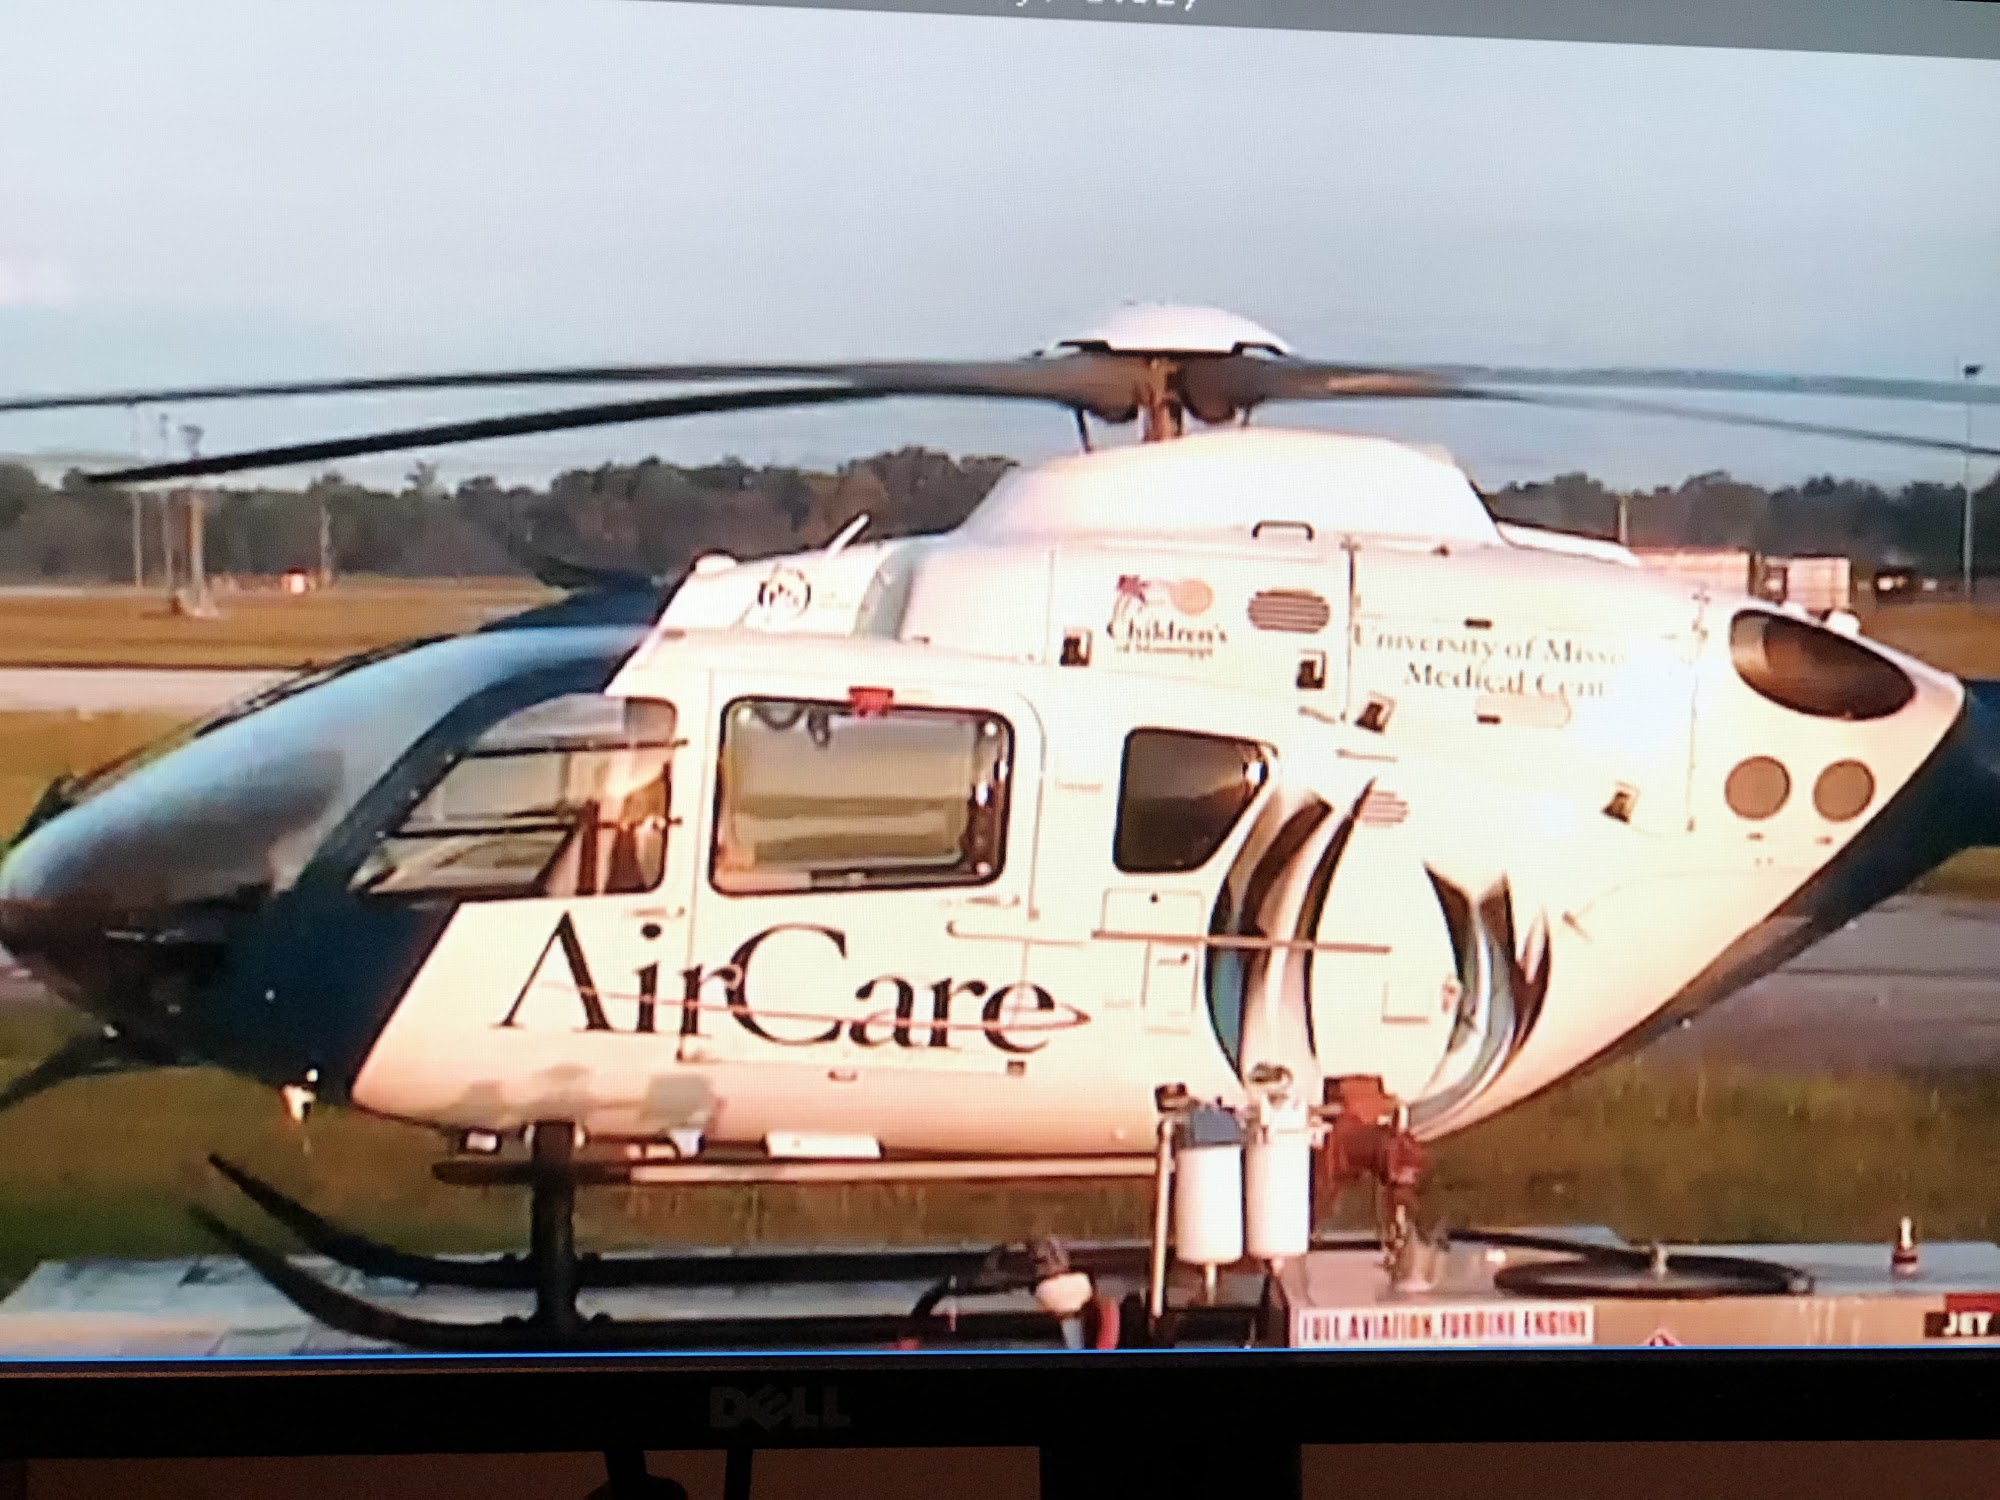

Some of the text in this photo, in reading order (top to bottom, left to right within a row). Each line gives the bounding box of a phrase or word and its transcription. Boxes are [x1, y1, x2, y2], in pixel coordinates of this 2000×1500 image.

[1353, 624, 1498, 662] University
[1505, 635, 1537, 660] of
[1405, 661, 1525, 696] Medical
[491, 910, 1055, 1053] AirCare
[709, 1384, 852, 1432] DELL
